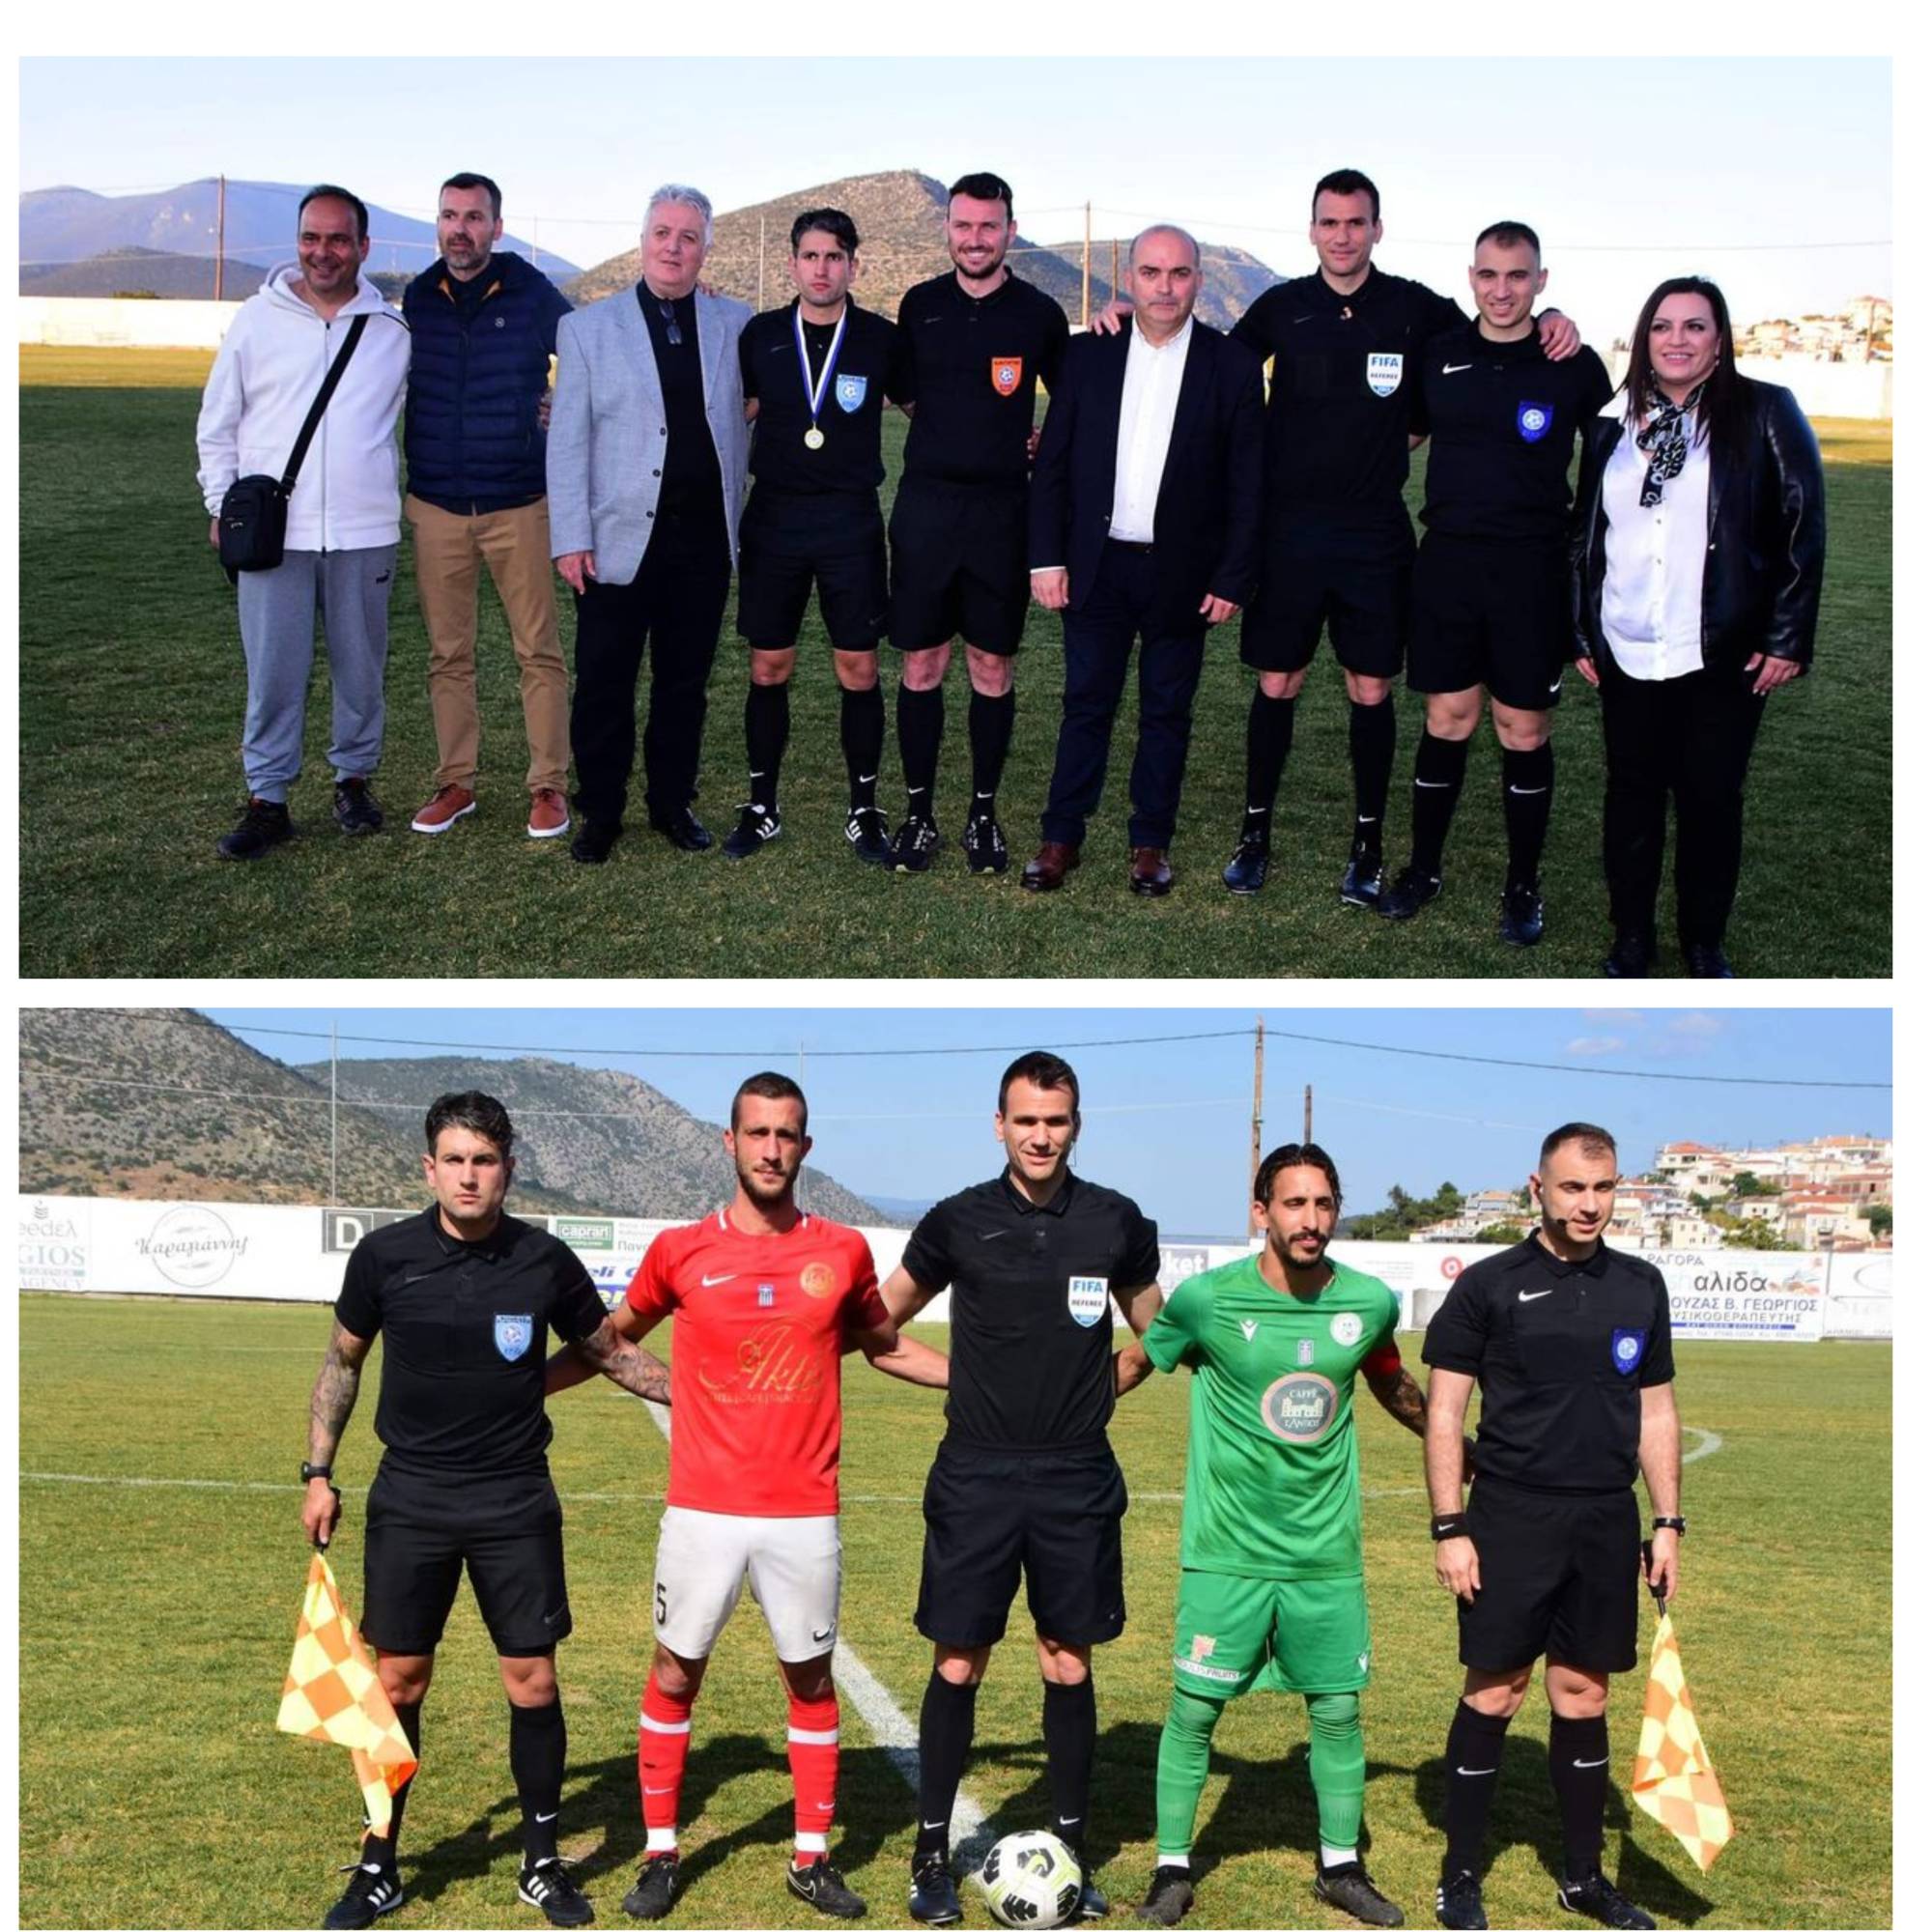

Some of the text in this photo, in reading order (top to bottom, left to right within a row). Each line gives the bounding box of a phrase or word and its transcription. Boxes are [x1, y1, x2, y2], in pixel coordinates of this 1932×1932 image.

[1371, 356, 1399, 367] FIFA
[18, 1244, 85, 1265] GIOS
[1647, 1253, 1705, 1266] ΡΑΓΟΡΑ
[587, 1265, 617, 1277] eli
[1072, 1280, 1104, 1293] FIFA
[1671, 1295, 1720, 1310] ΟΥΖΑΣ
[1744, 1297, 1818, 1312] ΓΕΩΡΓΙΟΣ
[1672, 1310, 1803, 1323] ΥΣΙΚΟΘΕΡΑΠΕΥΤΗΣ
[656, 1582, 668, 1626] 5
